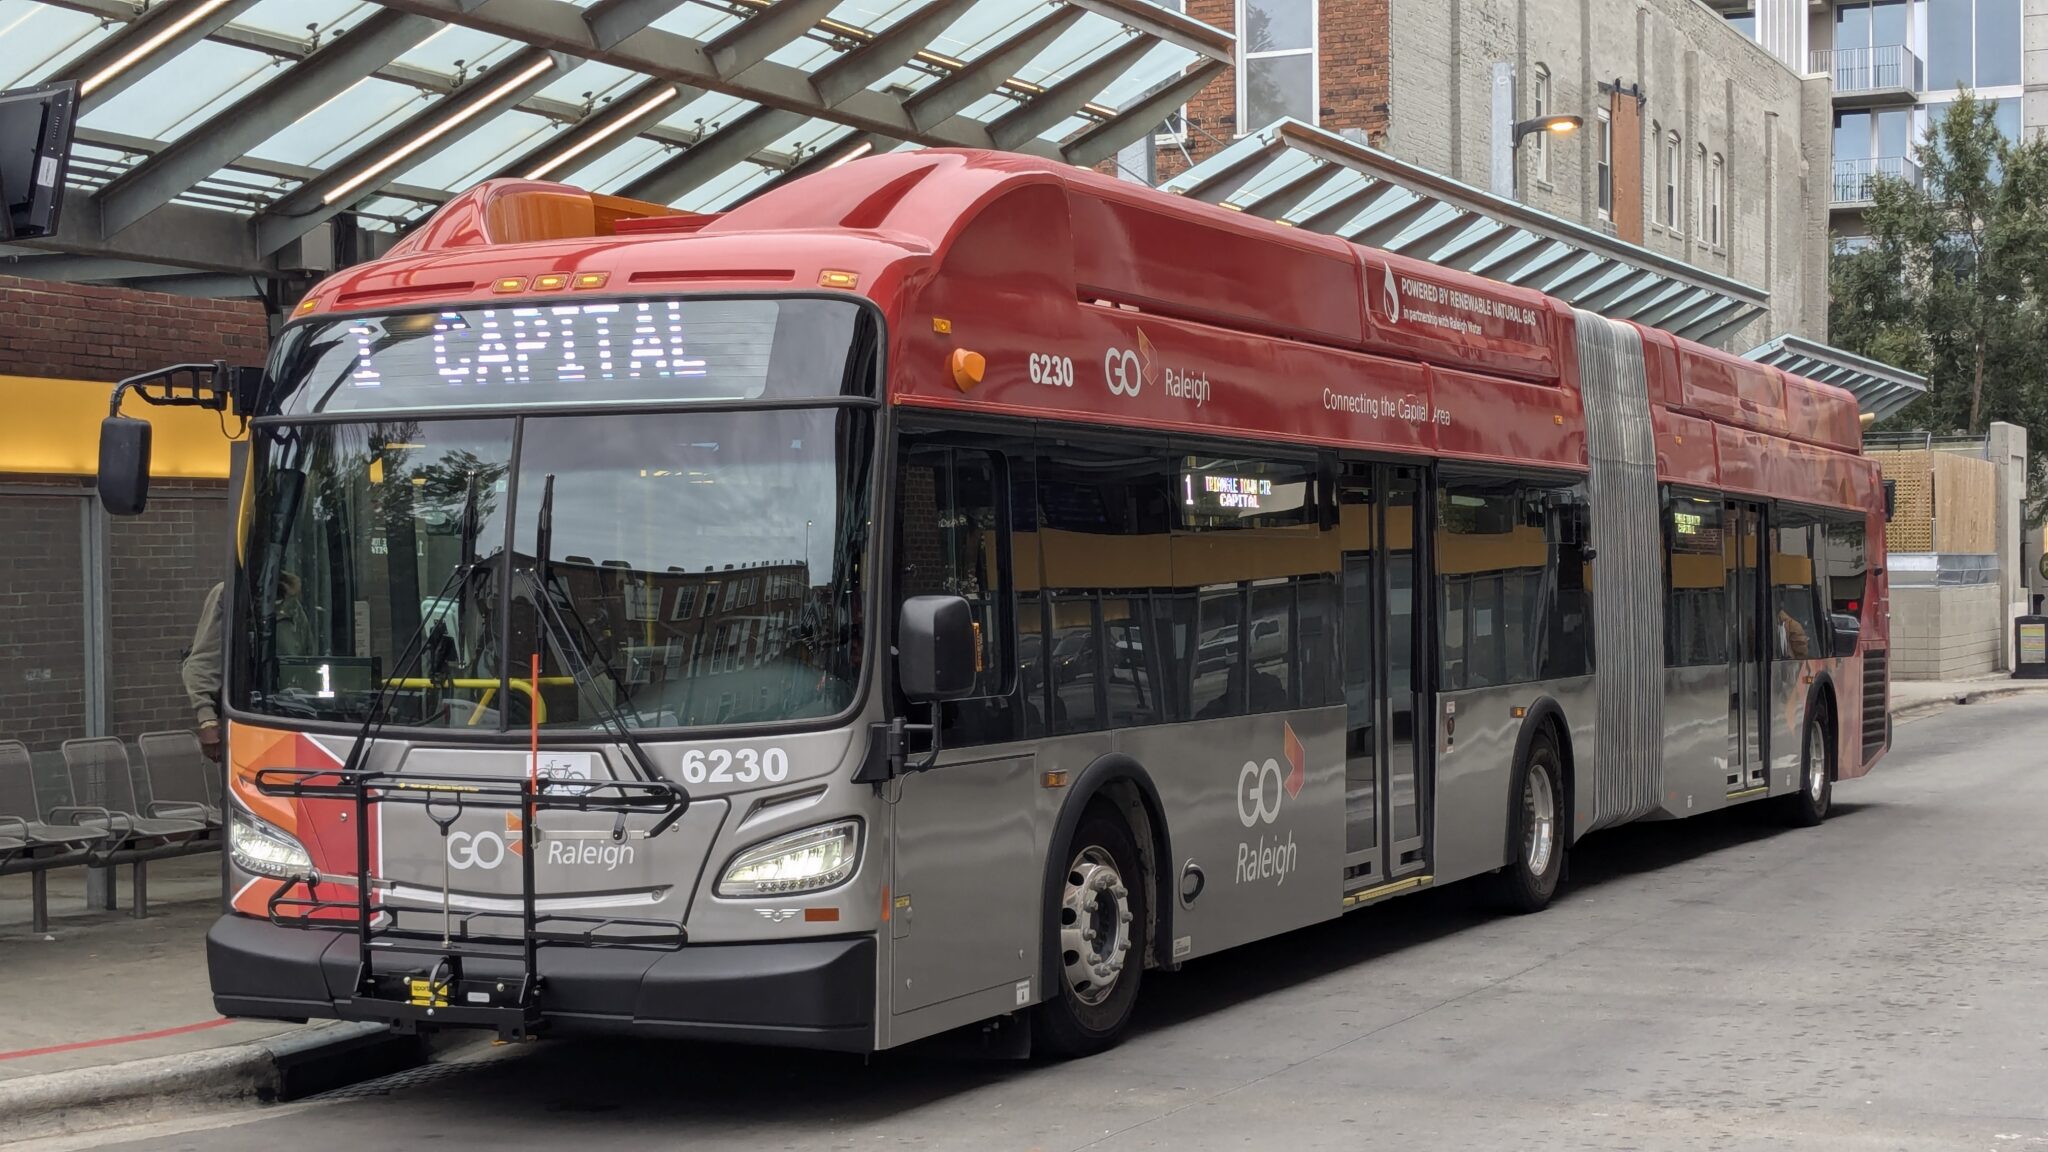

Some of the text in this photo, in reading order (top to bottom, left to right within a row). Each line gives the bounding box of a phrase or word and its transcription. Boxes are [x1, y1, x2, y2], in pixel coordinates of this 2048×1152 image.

[1401, 277, 1536, 326] POWERED BY RENEWABLE NATURAL GAS
[1410, 310, 1438, 328] partnership
[1438, 315, 1450, 328] with
[1449, 316, 1468, 335] Raleigh
[350, 301, 707, 386] 1 CAPITAL
[1029, 352, 1074, 388] 6230
[1104, 347, 1210, 408] GO Raleigh
[1323, 387, 1379, 419] Connecting
[1381, 395, 1396, 418] the
[1185, 473, 1194, 505] 1
[1219, 493, 1260, 508] CAPITAL
[1259, 479, 1272, 496] CTR
[316, 664, 335, 698] 1
[682, 747, 789, 784] 6230
[1237, 758, 1283, 828] GO
[447, 830, 635, 872] GO Raleigh
[1236, 829, 1297, 887] Raleigh
